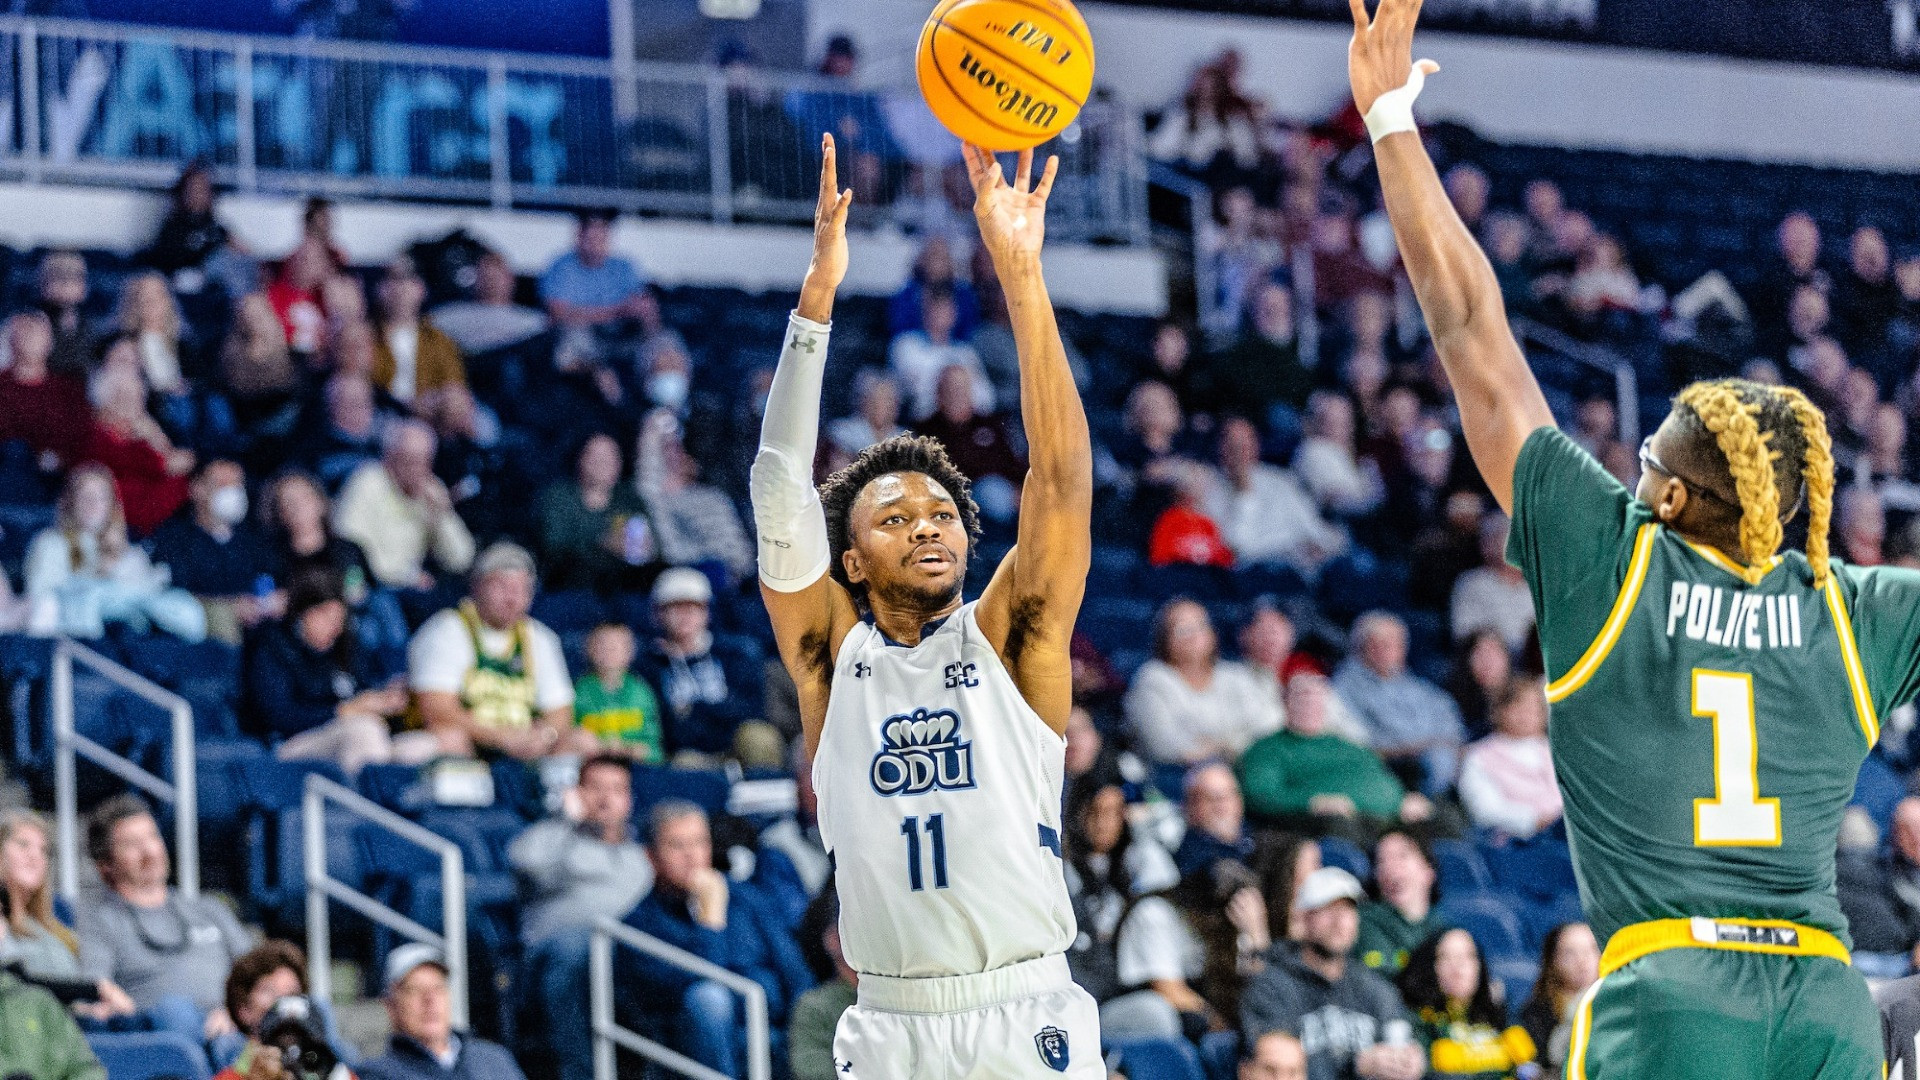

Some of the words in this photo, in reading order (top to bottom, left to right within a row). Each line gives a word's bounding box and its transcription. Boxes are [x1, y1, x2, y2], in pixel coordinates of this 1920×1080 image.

[958, 49, 1059, 128] Wilson
[1765, 593, 1801, 649] III
[870, 744, 977, 797] ODU
[1691, 667, 1782, 847] 1
[900, 813, 949, 891] 11
